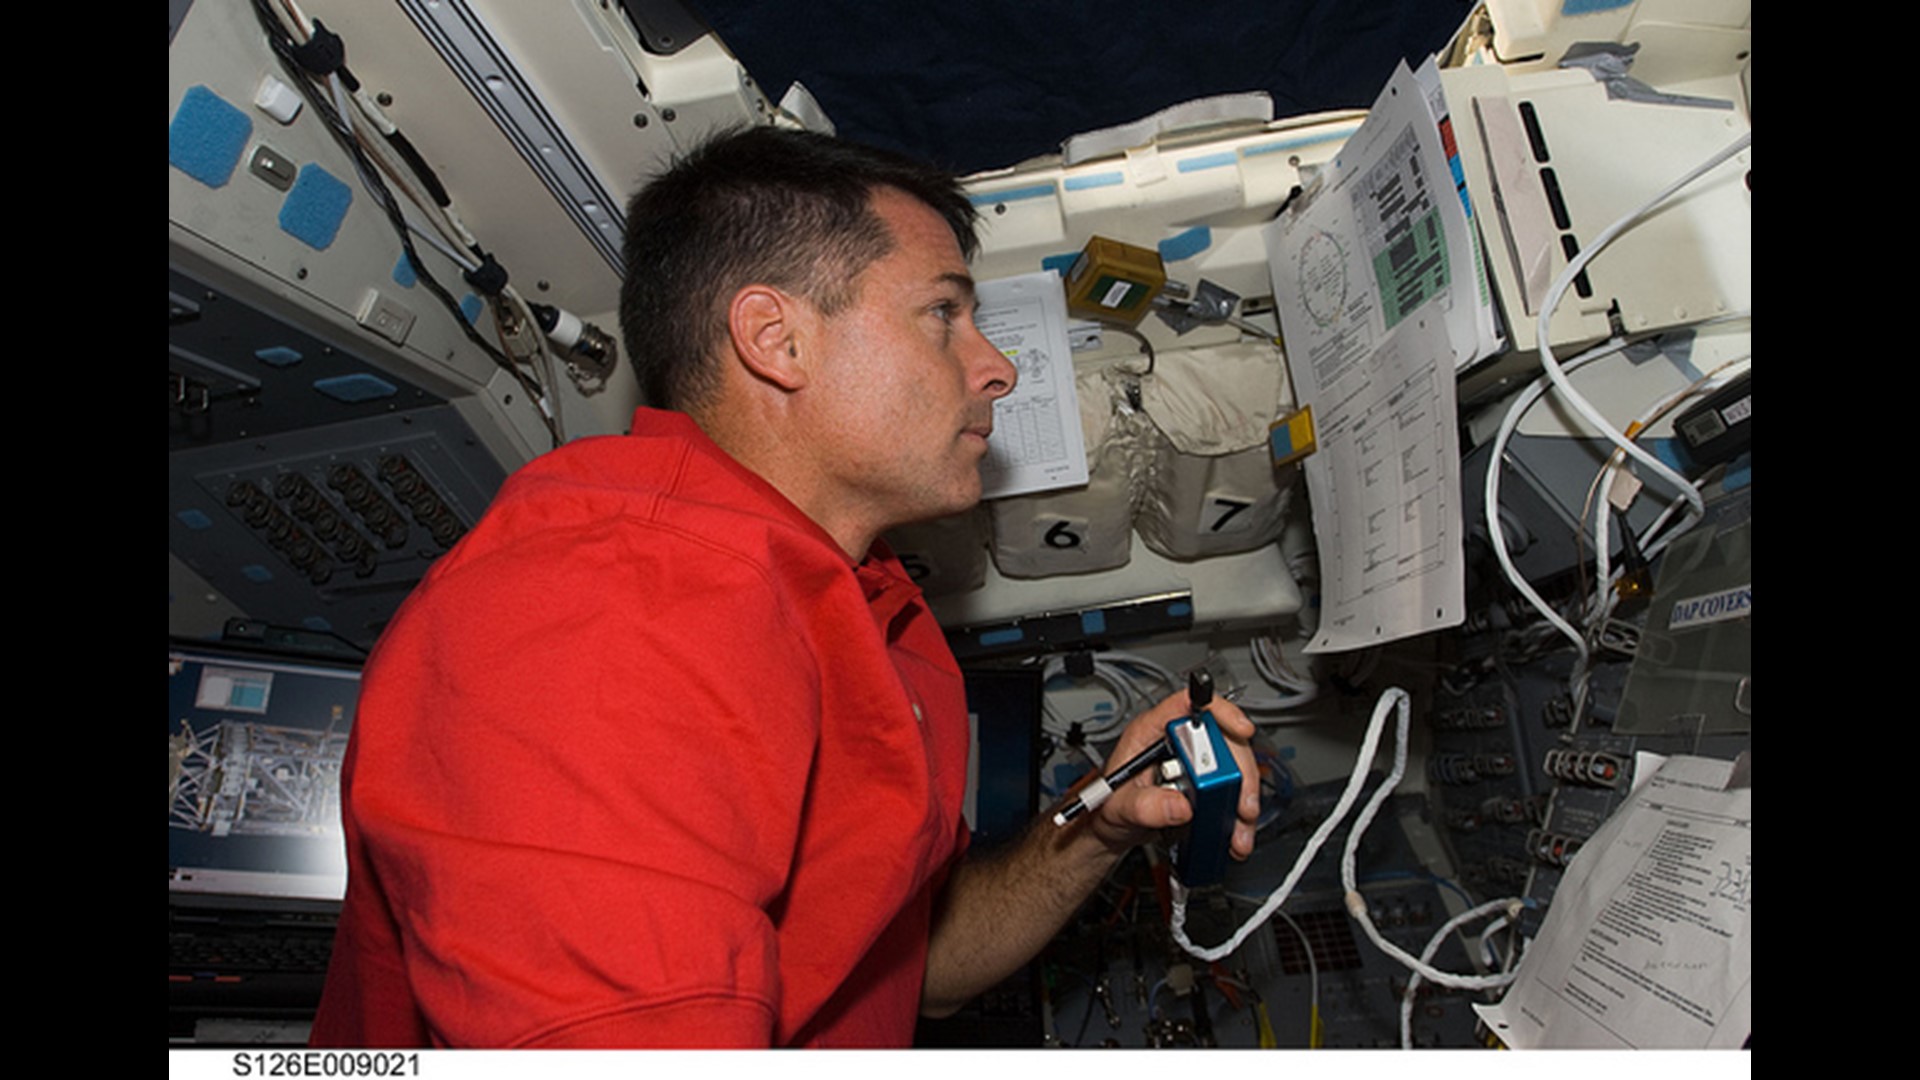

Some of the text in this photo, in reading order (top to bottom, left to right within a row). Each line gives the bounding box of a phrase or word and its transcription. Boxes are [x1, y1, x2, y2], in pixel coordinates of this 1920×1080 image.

[1213, 498, 1250, 531] 7
[1044, 520, 1080, 549] 6
[898, 553, 931, 581] 5
